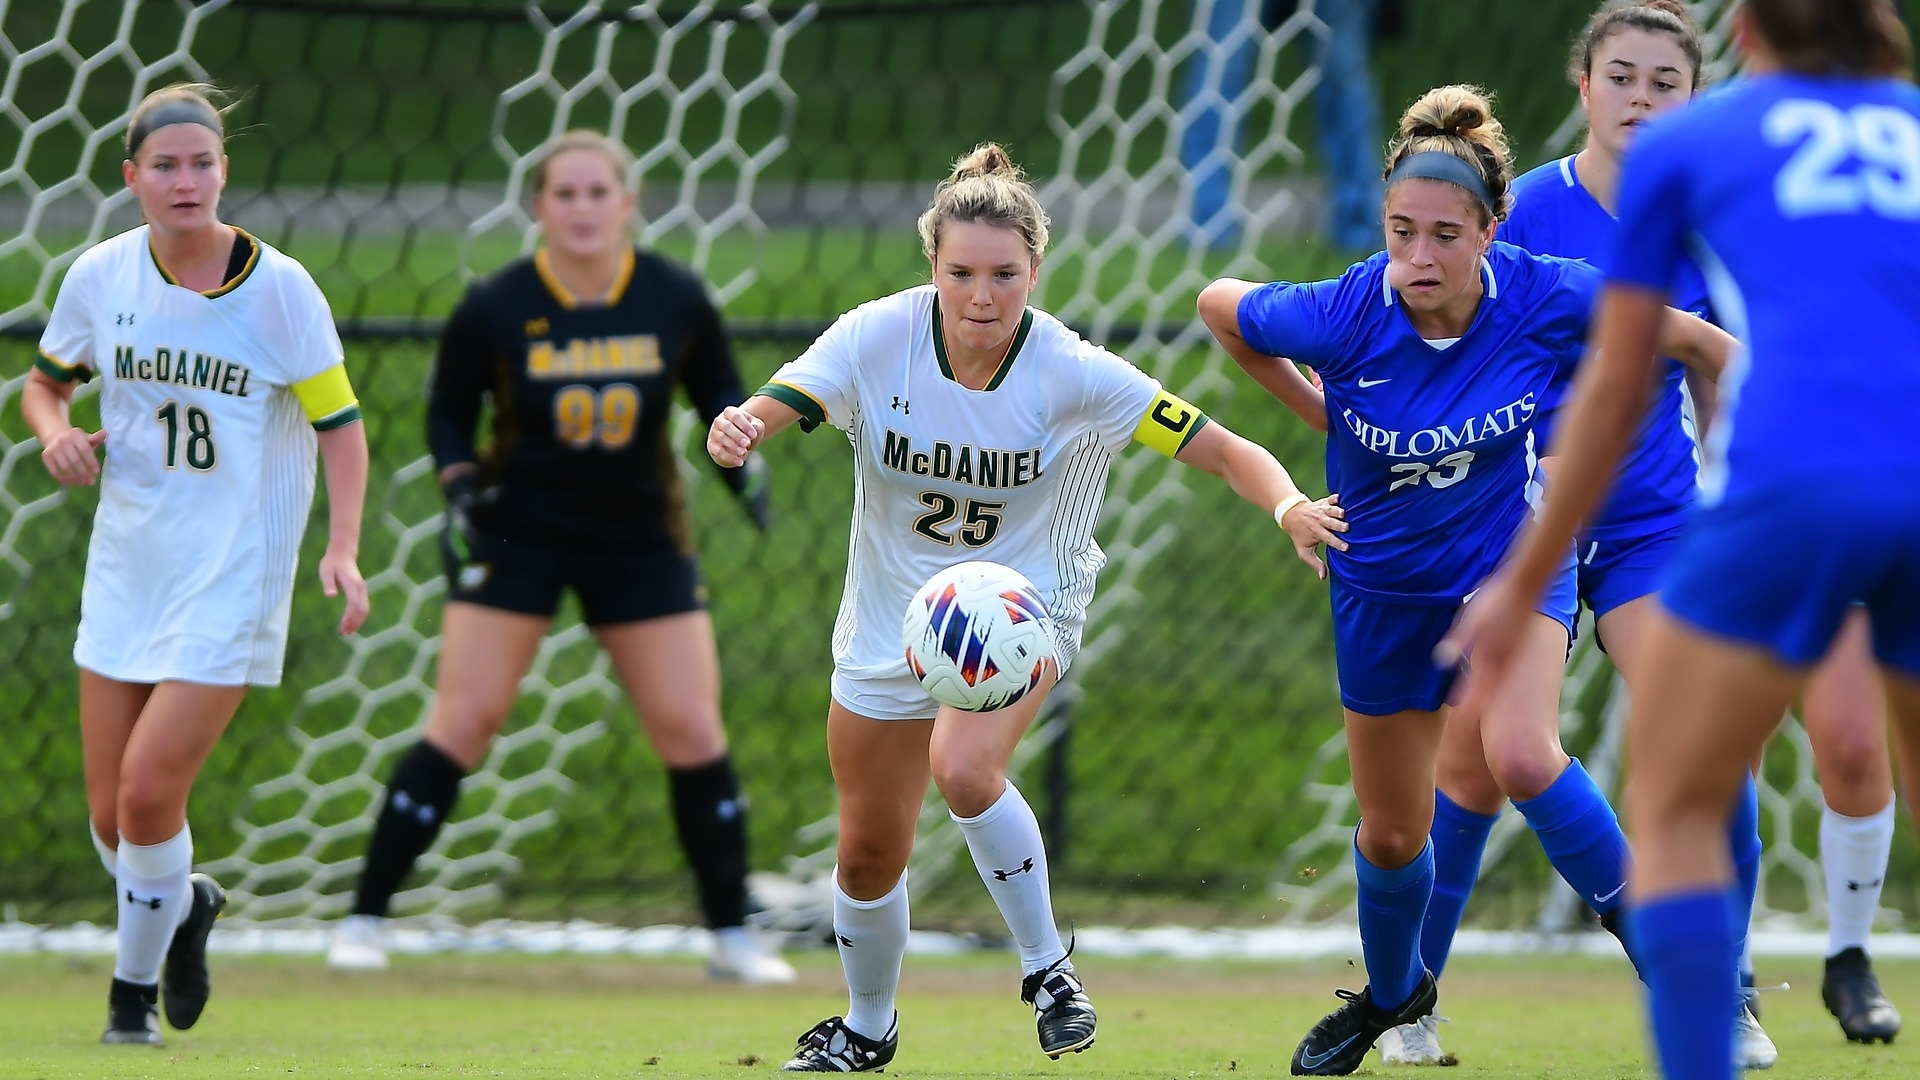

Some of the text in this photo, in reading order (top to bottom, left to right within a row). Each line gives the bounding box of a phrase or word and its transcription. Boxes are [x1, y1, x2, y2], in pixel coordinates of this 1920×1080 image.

[1760, 98, 1920, 221] 29
[113, 344, 250, 398] McDANIEL
[155, 399, 217, 473] 18
[553, 383, 643, 448] 99
[1151, 399, 1191, 433] C
[1343, 391, 1536, 458] DIPLOMATS
[882, 427, 1044, 489] McDANIEL
[1389, 450, 1476, 492] 23
[912, 490, 1007, 548] 25
